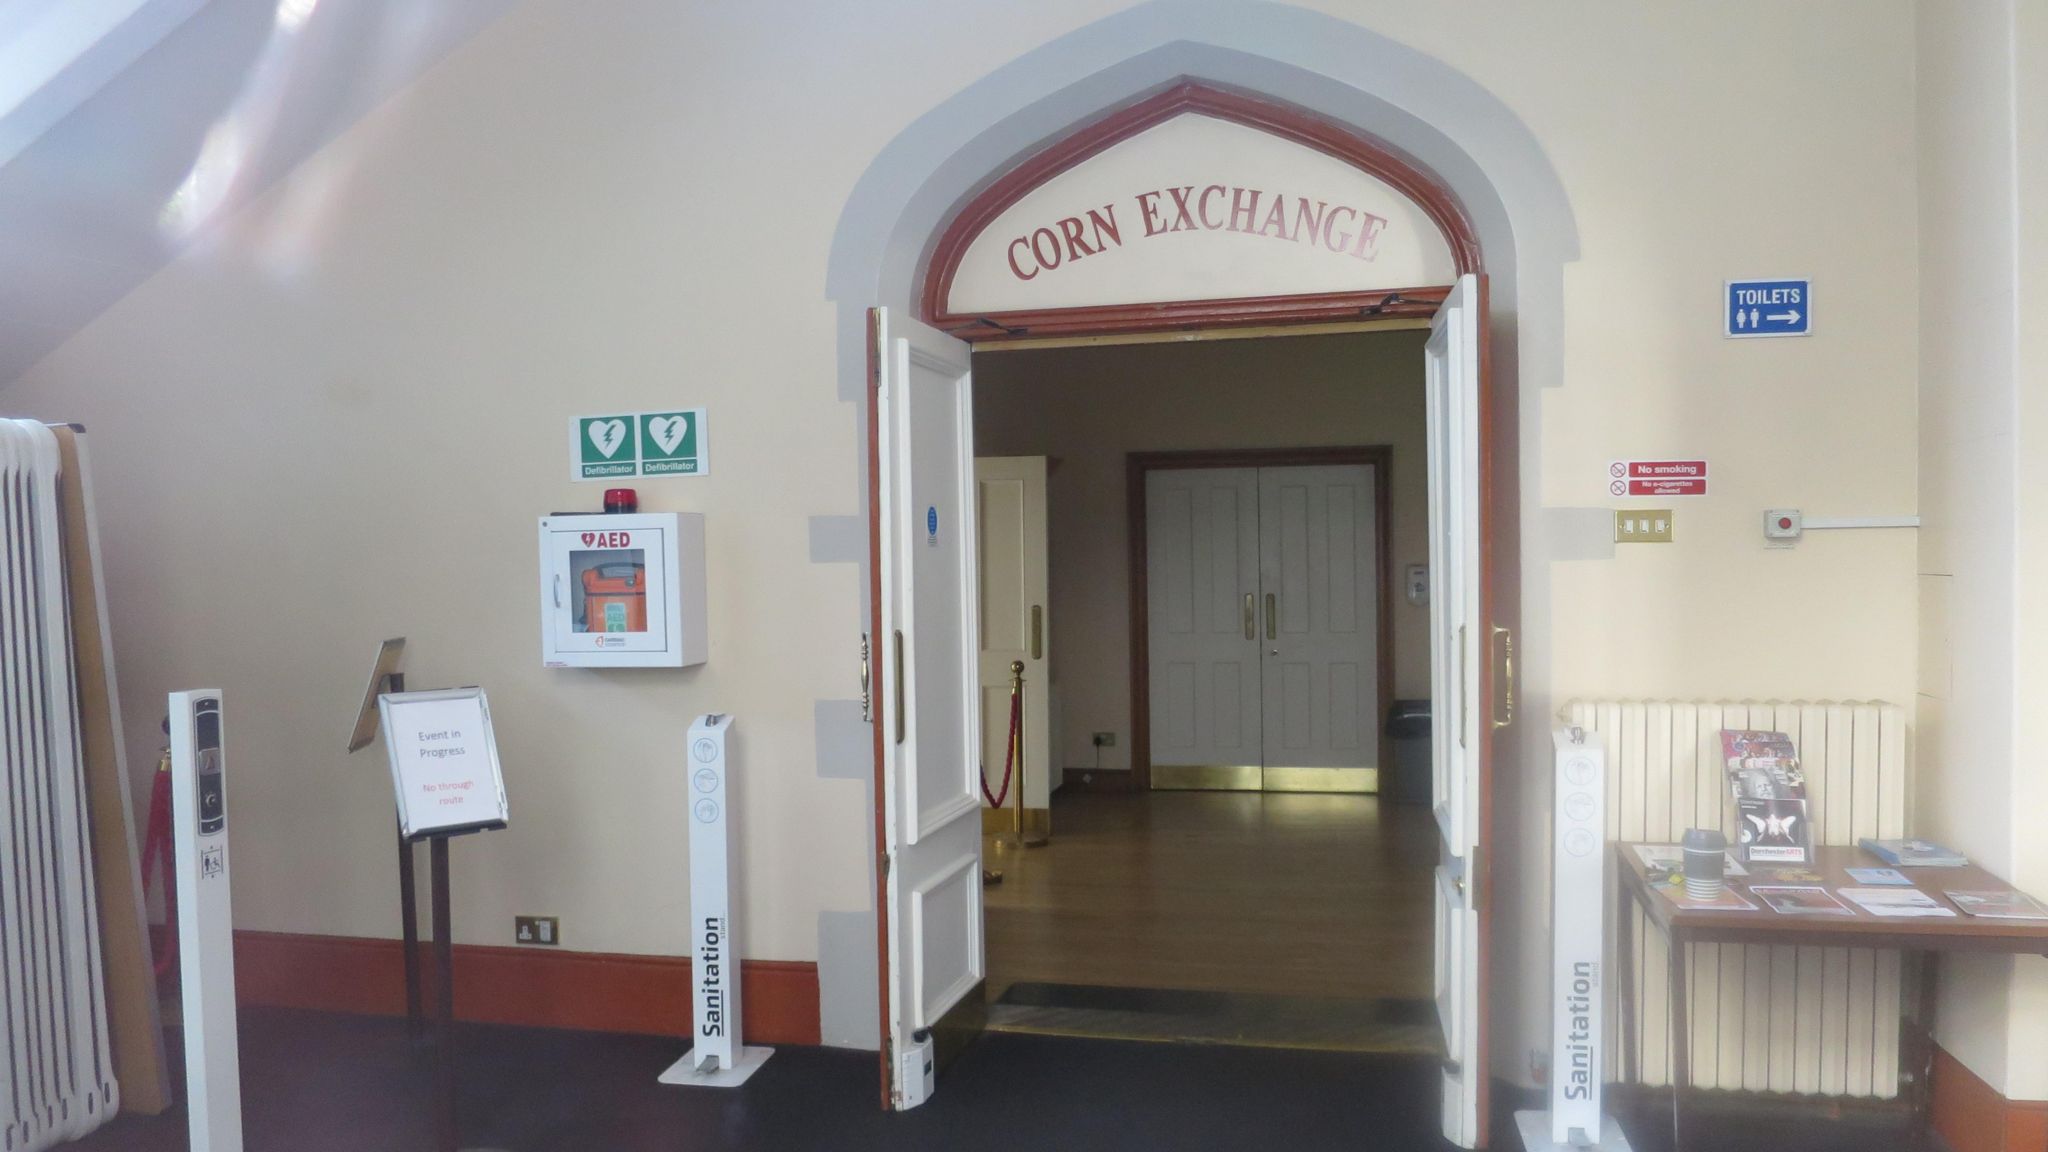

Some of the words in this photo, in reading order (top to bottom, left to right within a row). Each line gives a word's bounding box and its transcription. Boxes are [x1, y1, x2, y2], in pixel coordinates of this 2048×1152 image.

[1007, 203, 1122, 281] CORN
[1134, 184, 1388, 263] EXCHANGE
[1736, 288, 1801, 305] TOILETS
[584, 465, 634, 475] Defibrillator
[645, 462, 695, 472] Defibrillator
[1638, 465, 1653, 474] No
[1654, 464, 1697, 475] smoking
[597, 532, 631, 548] AED
[418, 731, 448, 741] Event
[451, 729, 461, 739] in
[420, 747, 466, 758] Progress
[423, 784, 436, 792] No
[438, 781, 474, 791] through
[439, 796, 463, 805] route
[701, 917, 720, 1037] Sanitation
[1564, 962, 1590, 1100] Sanitation
